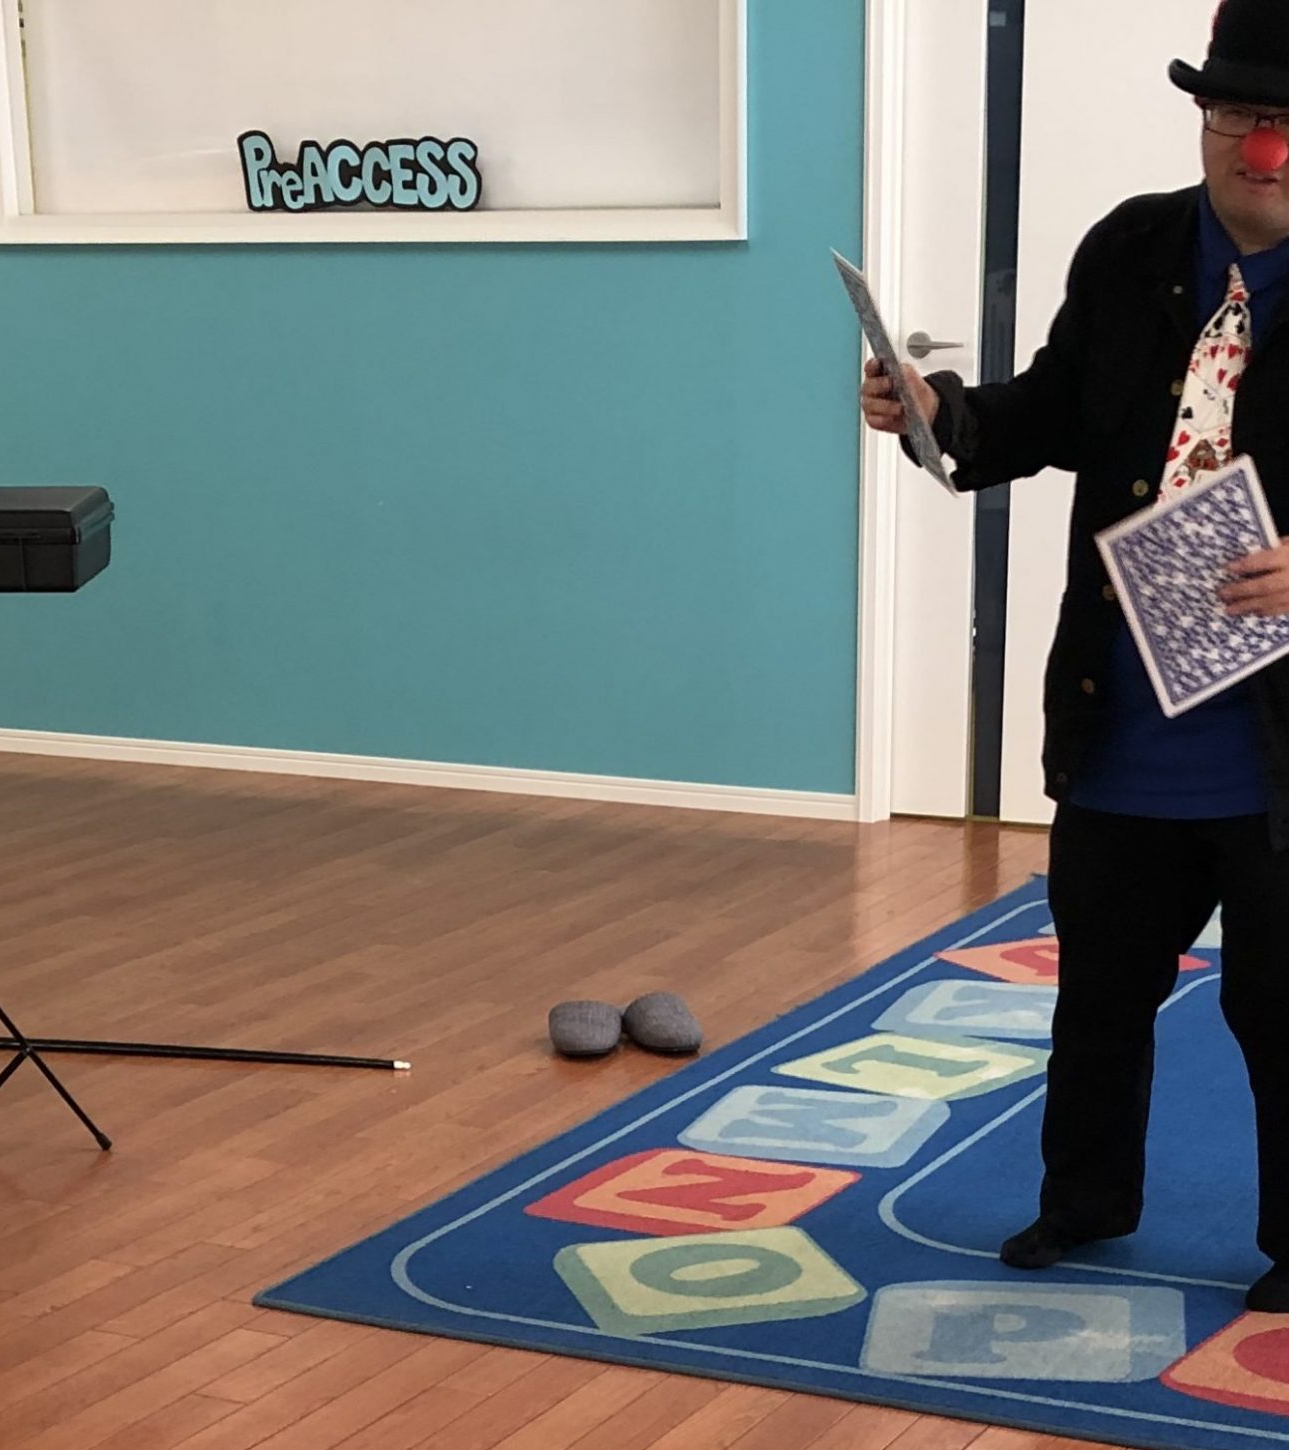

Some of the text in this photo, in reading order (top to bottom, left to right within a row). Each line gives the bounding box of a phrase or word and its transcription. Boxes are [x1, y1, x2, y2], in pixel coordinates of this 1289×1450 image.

[239, 132, 481, 211] PreACCESS
[615, 1158, 817, 1222] N
[628, 1242, 803, 1299] O
[913, 1302, 1087, 1366] P
